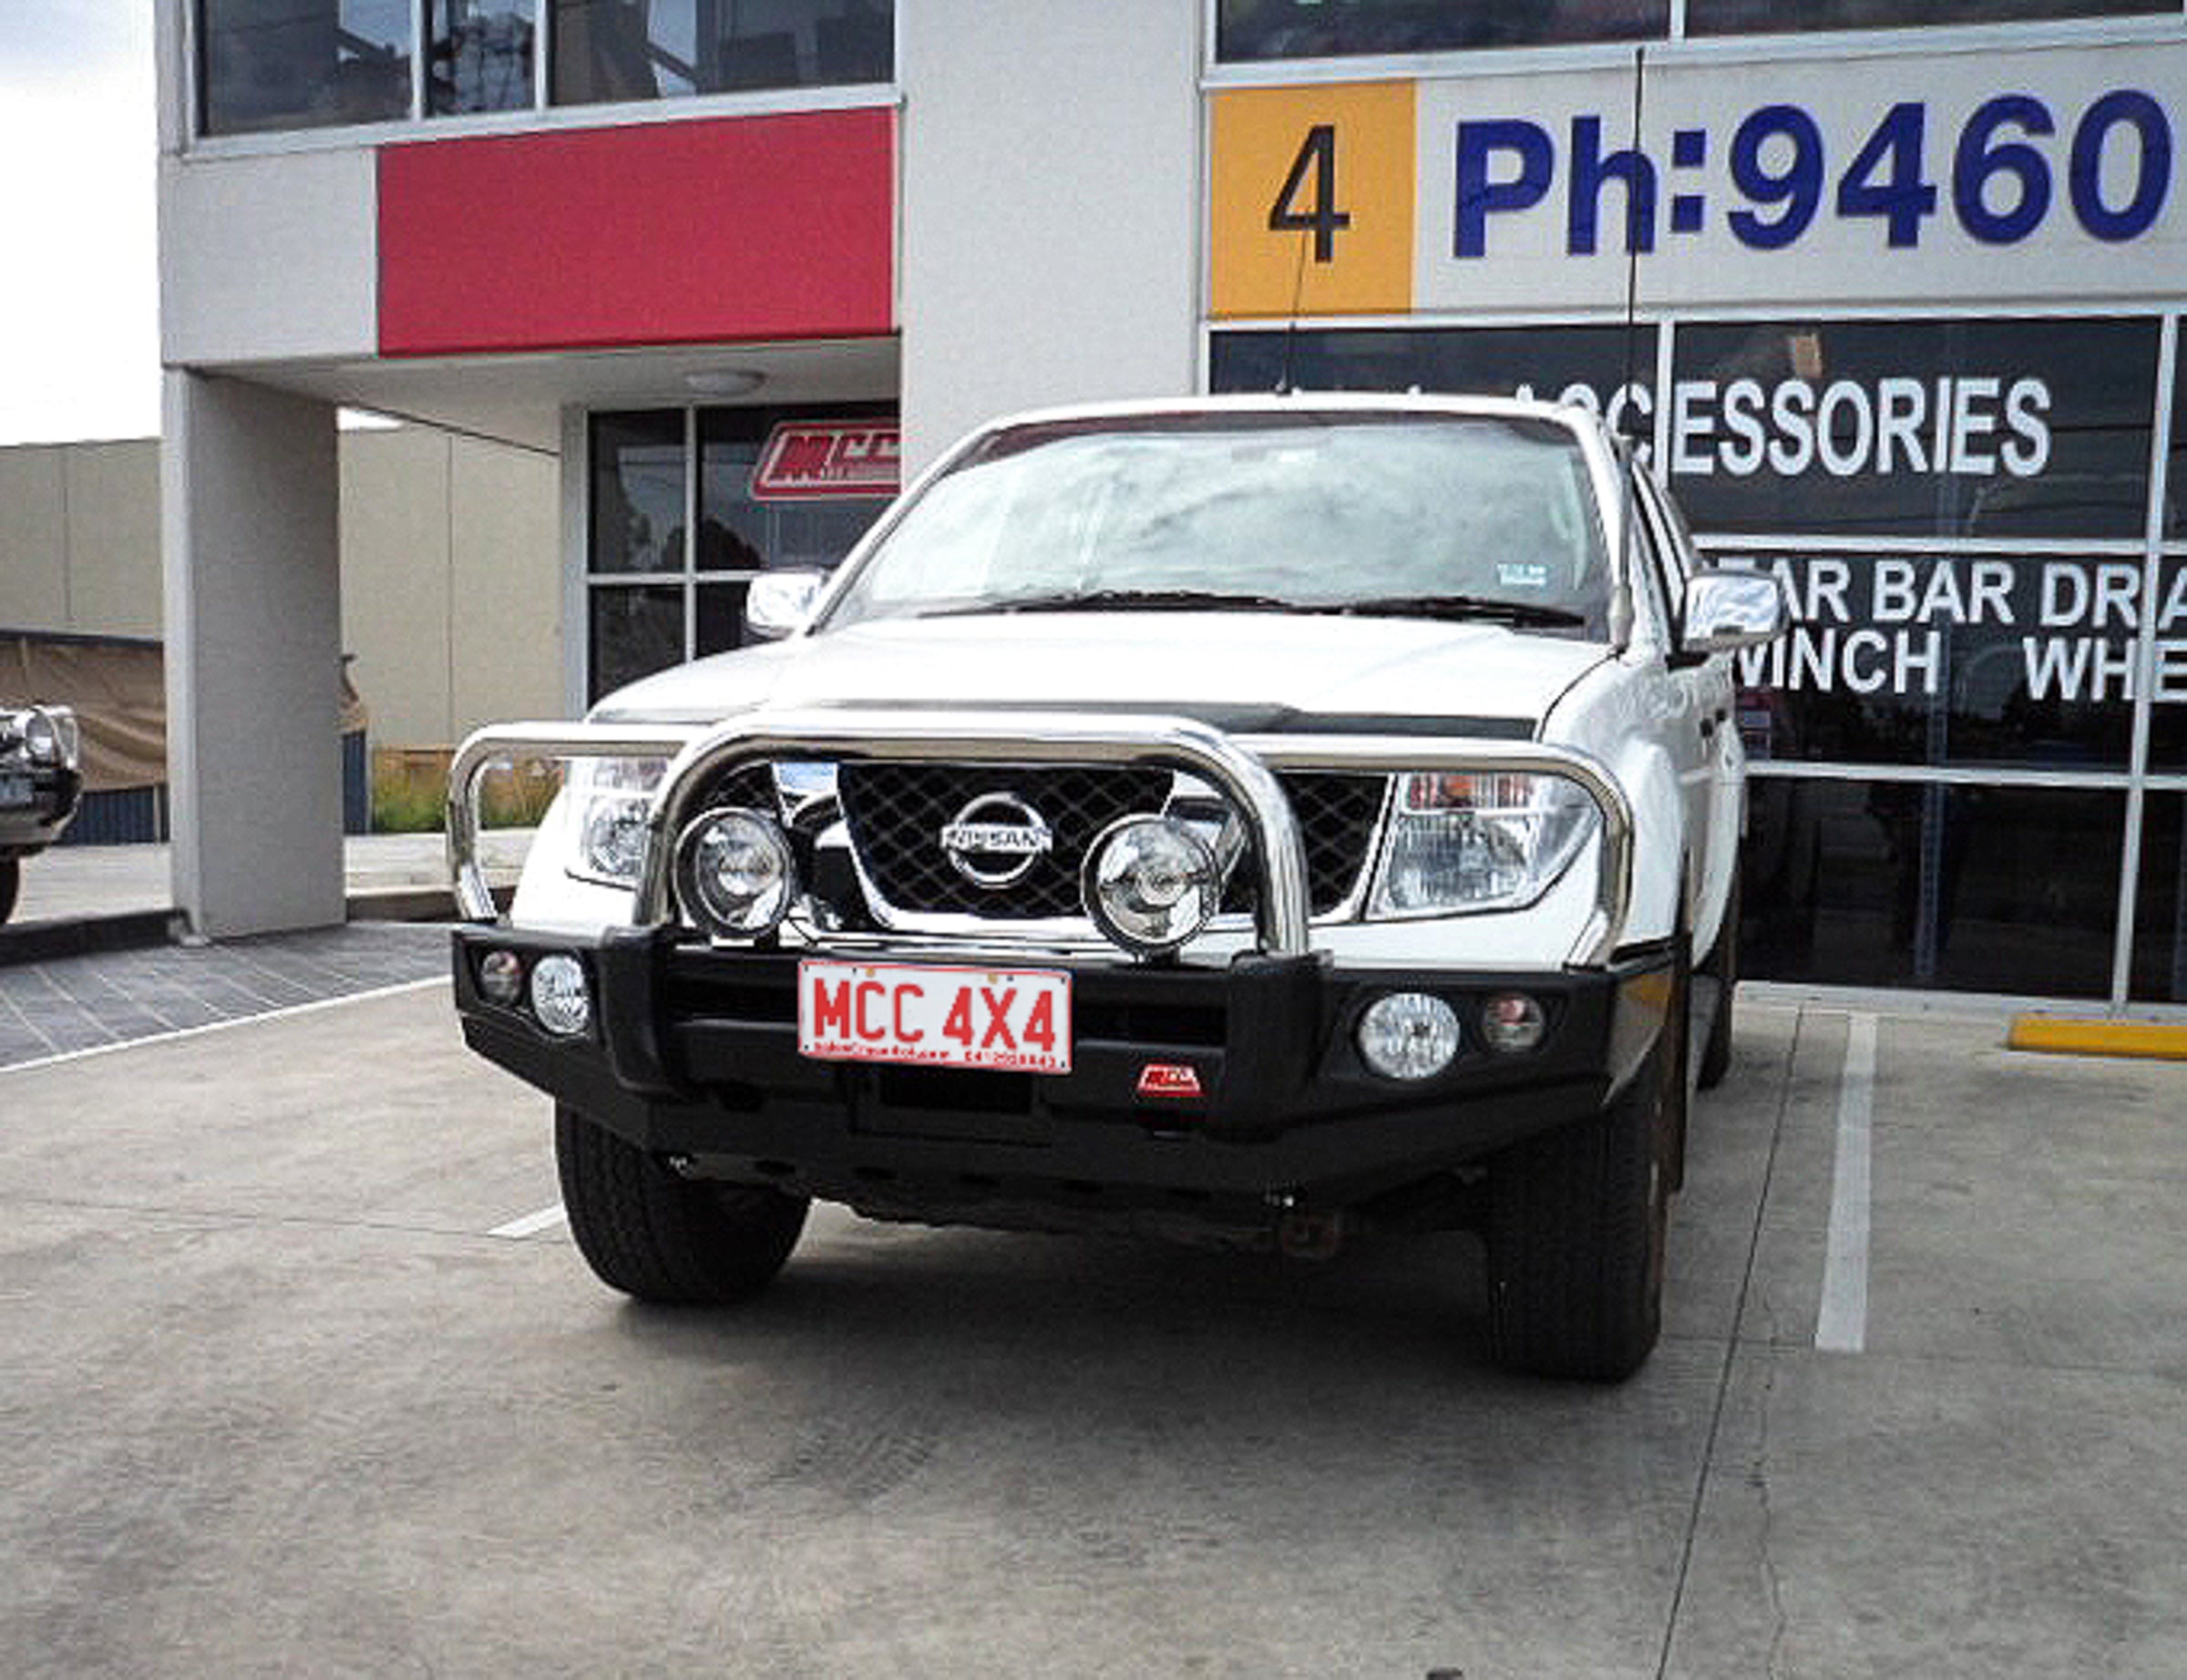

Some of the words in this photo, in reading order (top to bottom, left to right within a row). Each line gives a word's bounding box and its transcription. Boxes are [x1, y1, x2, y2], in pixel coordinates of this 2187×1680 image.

[1268, 124, 1351, 264] 4
[1453, 89, 2173, 259] Ph:9460
[1872, 558, 2016, 624] BAR
[945, 824, 1047, 849] NISSAN
[814, 977, 925, 1043] MCC
[941, 986, 1056, 1052] 4X4
